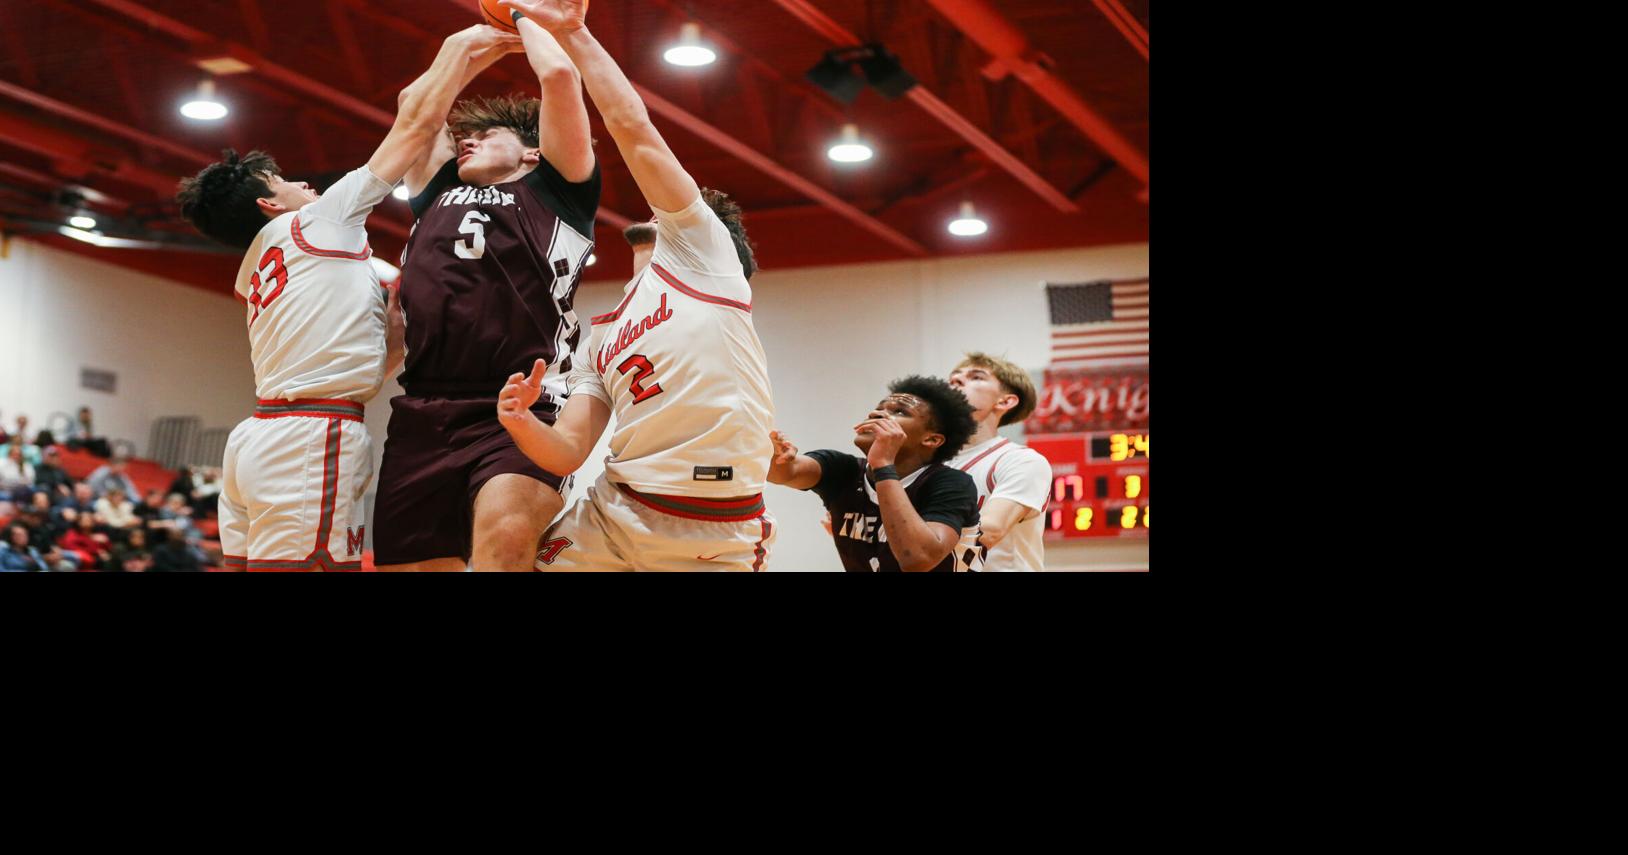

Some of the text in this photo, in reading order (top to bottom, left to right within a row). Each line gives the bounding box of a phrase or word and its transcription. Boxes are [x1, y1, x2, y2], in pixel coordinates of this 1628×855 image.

[454, 210, 491, 259] 5
[616, 354, 664, 405] 2
[721, 470, 729, 478] M
[347, 524, 365, 556] M
